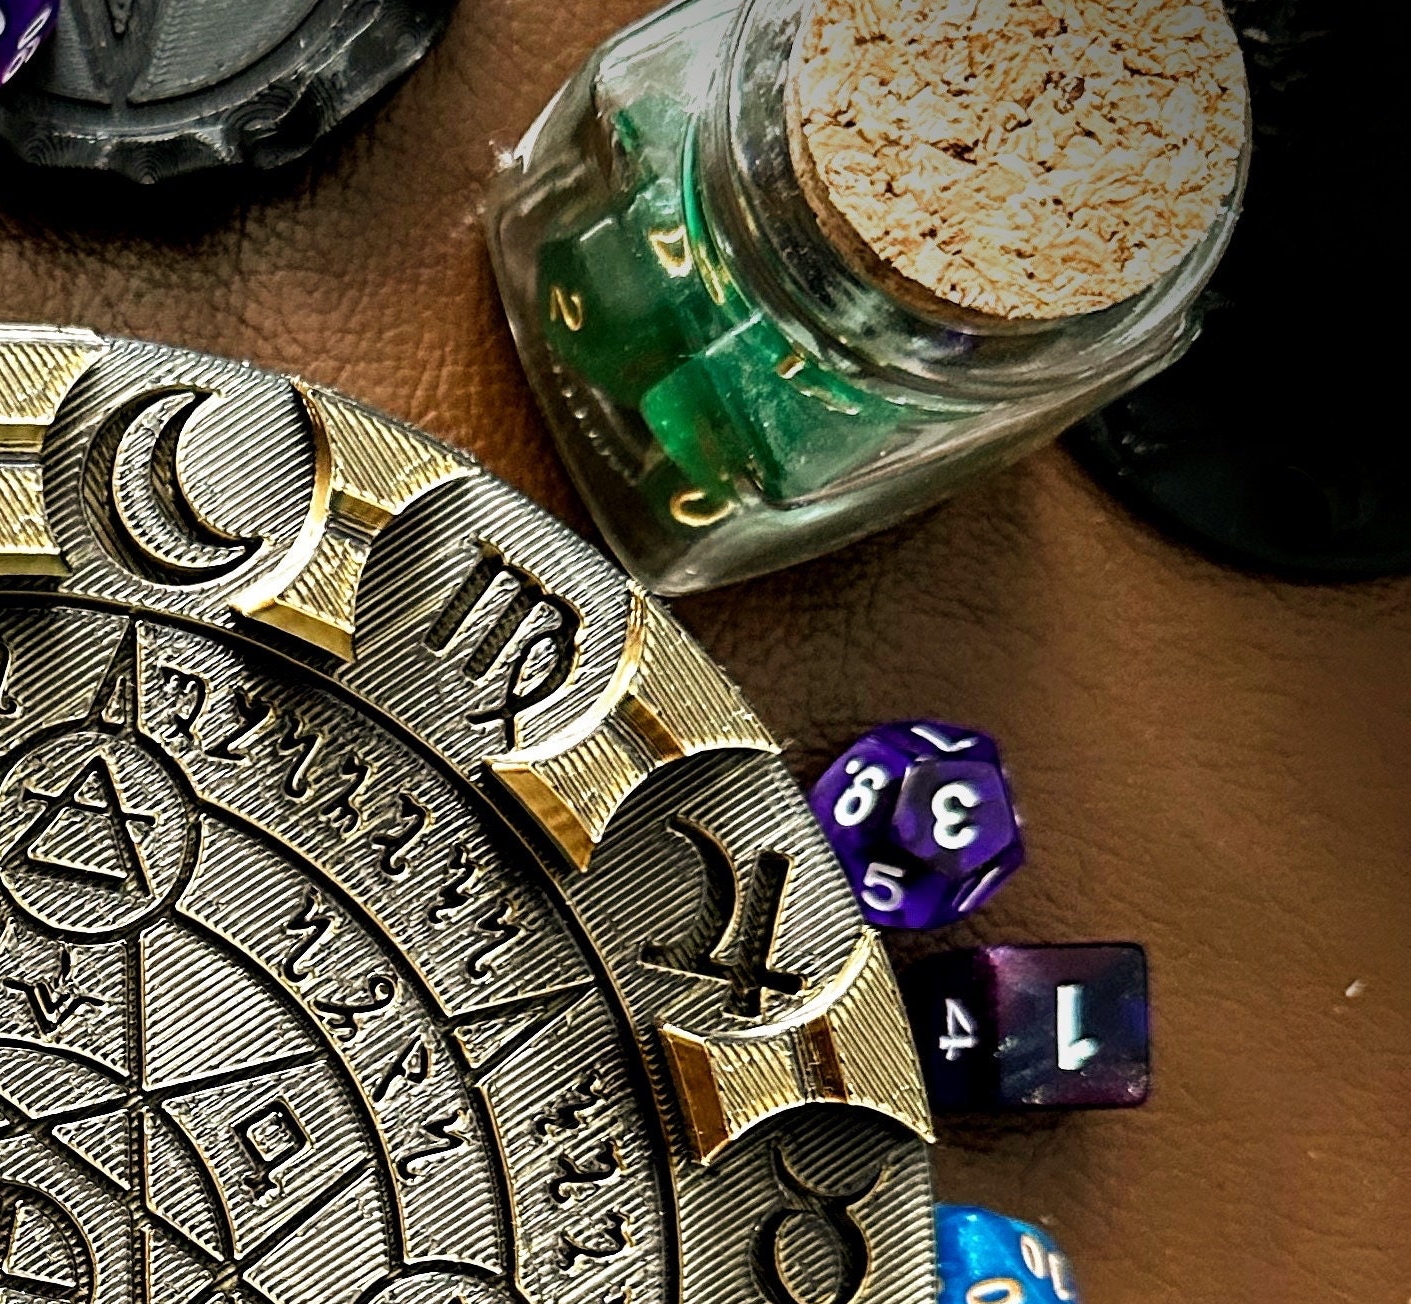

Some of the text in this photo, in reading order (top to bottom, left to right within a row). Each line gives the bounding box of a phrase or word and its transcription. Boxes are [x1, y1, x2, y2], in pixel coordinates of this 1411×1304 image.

[931, 781, 980, 850] 3
[860, 862, 906, 912] 5
[939, 997, 980, 1061] 4
[1056, 983, 1101, 1071] 1
